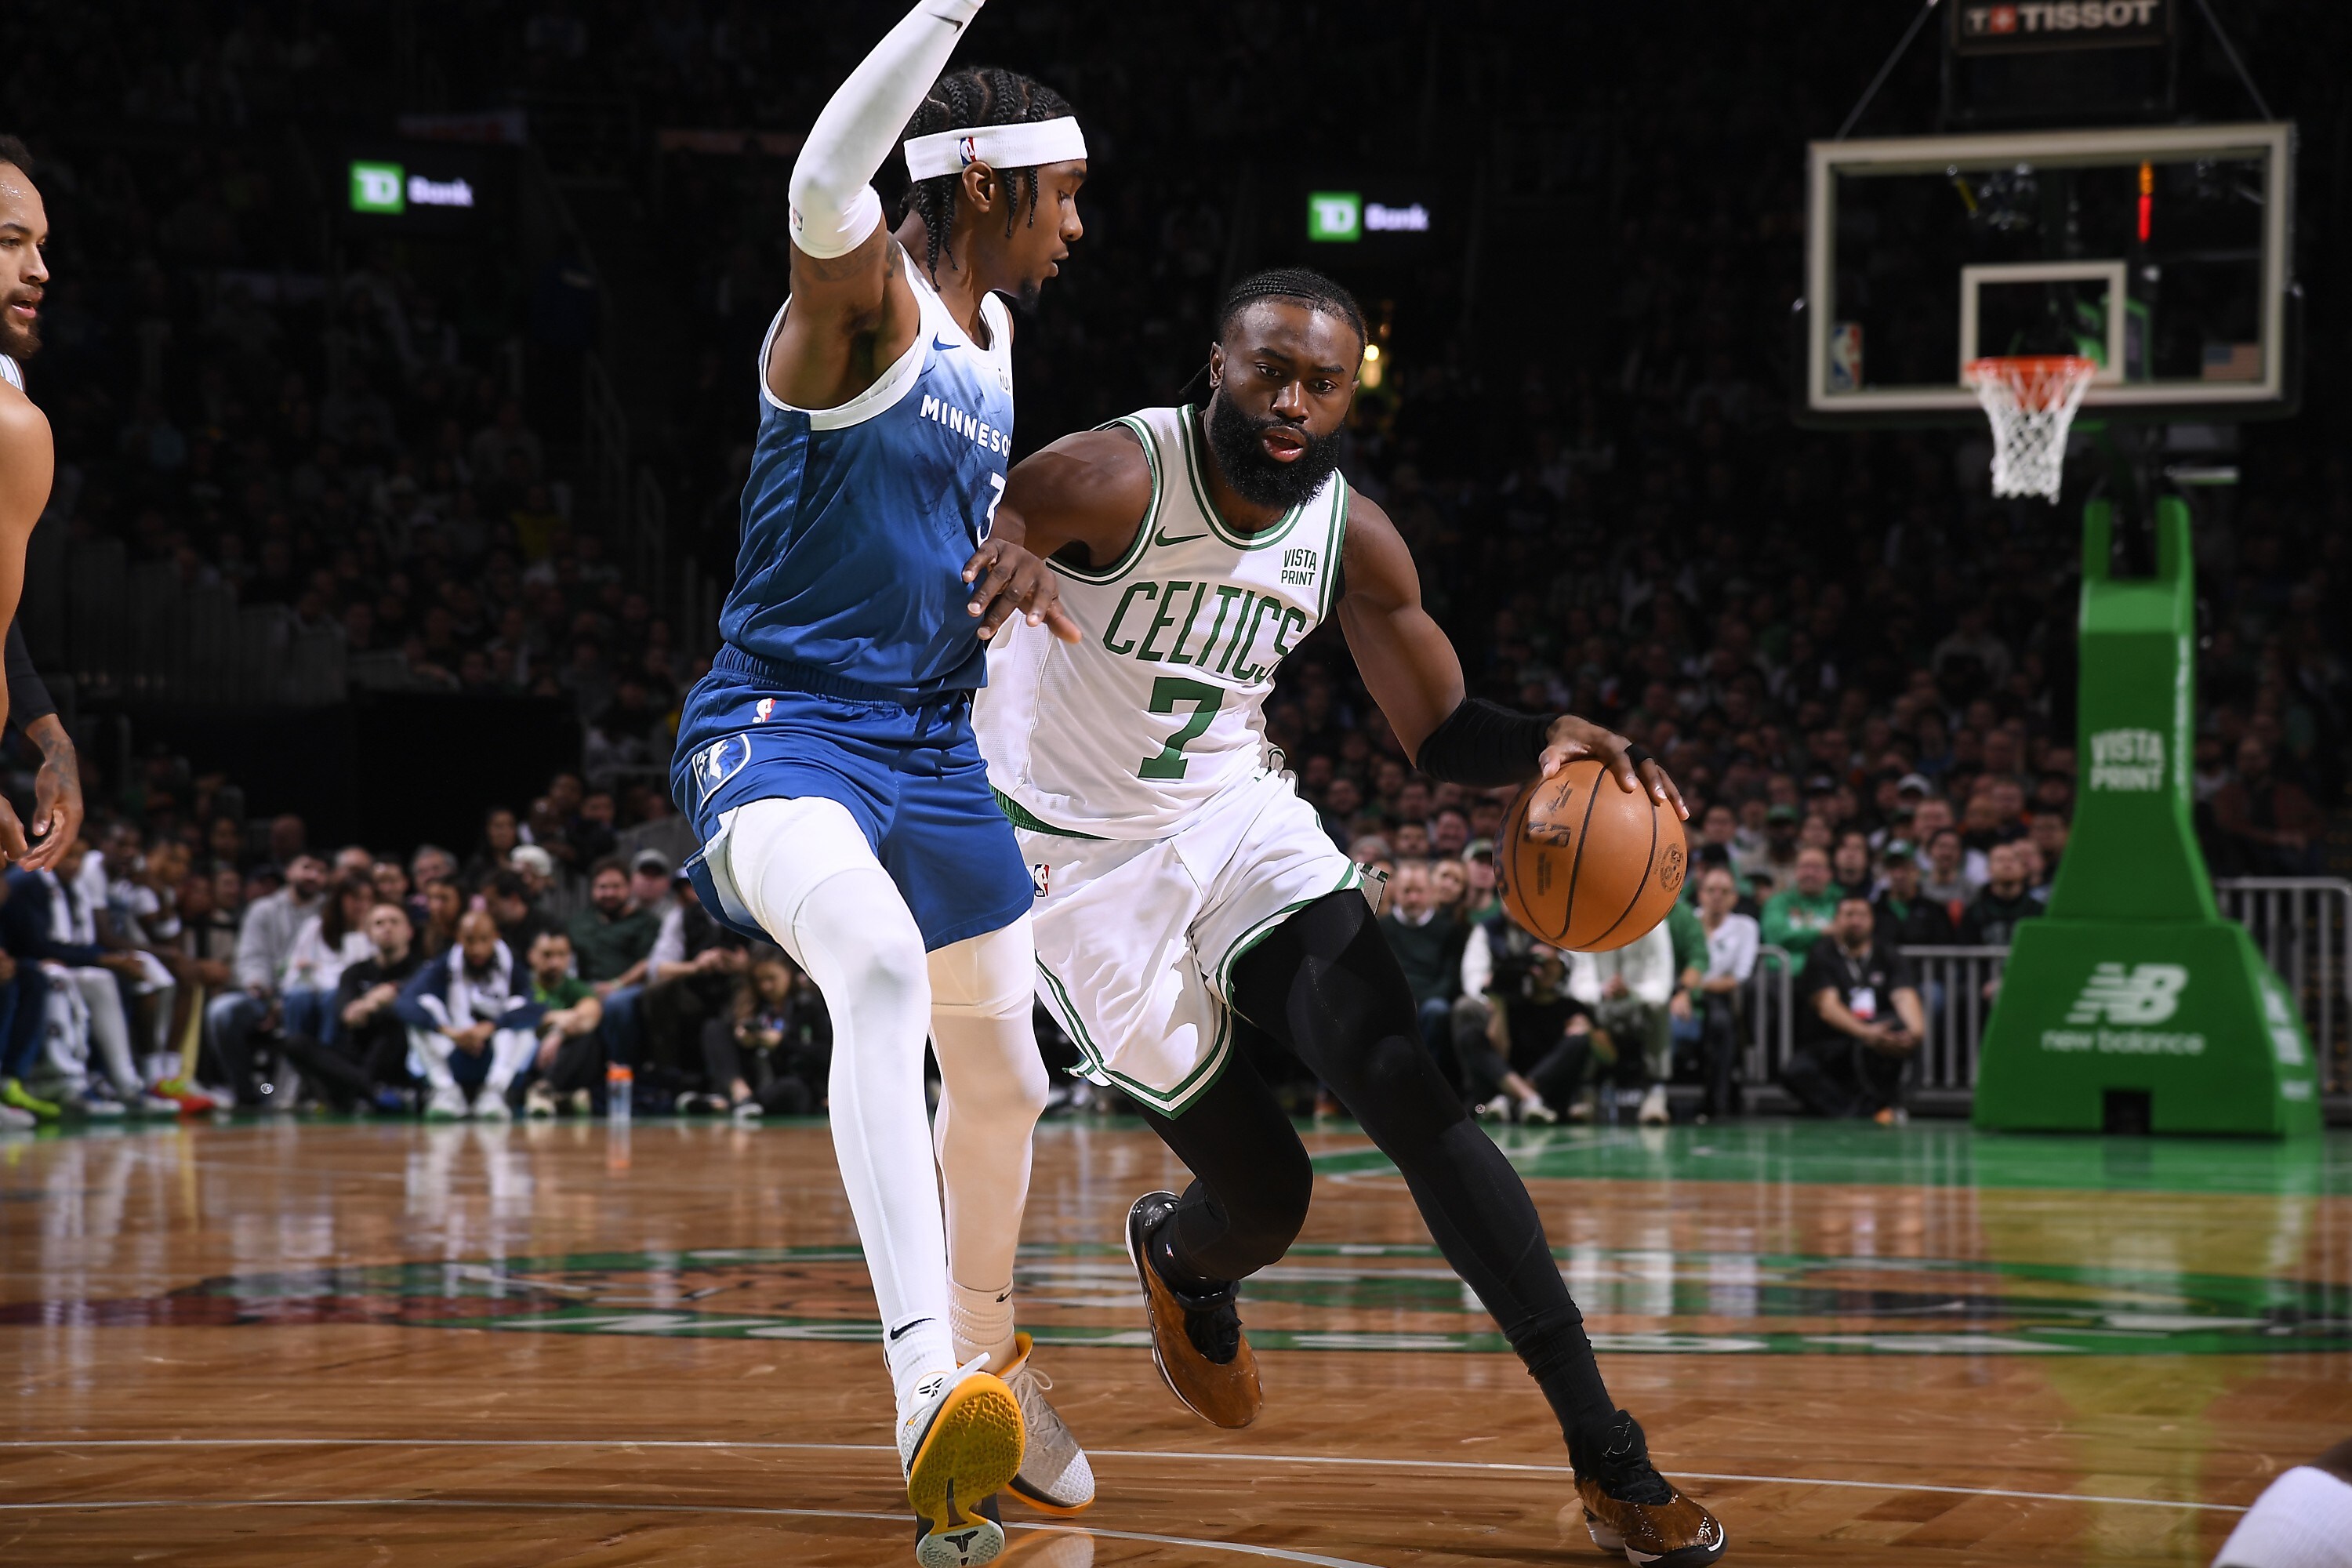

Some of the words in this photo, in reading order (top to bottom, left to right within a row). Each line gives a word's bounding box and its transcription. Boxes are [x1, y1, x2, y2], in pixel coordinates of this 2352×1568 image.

[2017, 0, 2158, 31] TISSOT
[357, 168, 401, 205] TD
[408, 177, 473, 206] Bank
[1313, 198, 1357, 234] TD
[1364, 203, 1428, 231] Bank
[920, 394, 1011, 461] MINNESO
[1281, 570, 1315, 586] PRINT
[1283, 549, 1316, 571] VISTA
[1102, 581, 1307, 684] CELTICS
[1138, 677, 1225, 779] 7
[2090, 728, 2165, 764] VISTA
[2090, 765, 2165, 792] PRINT
[2042, 1031, 2093, 1051] new
[2097, 1028, 2205, 1055] balance
